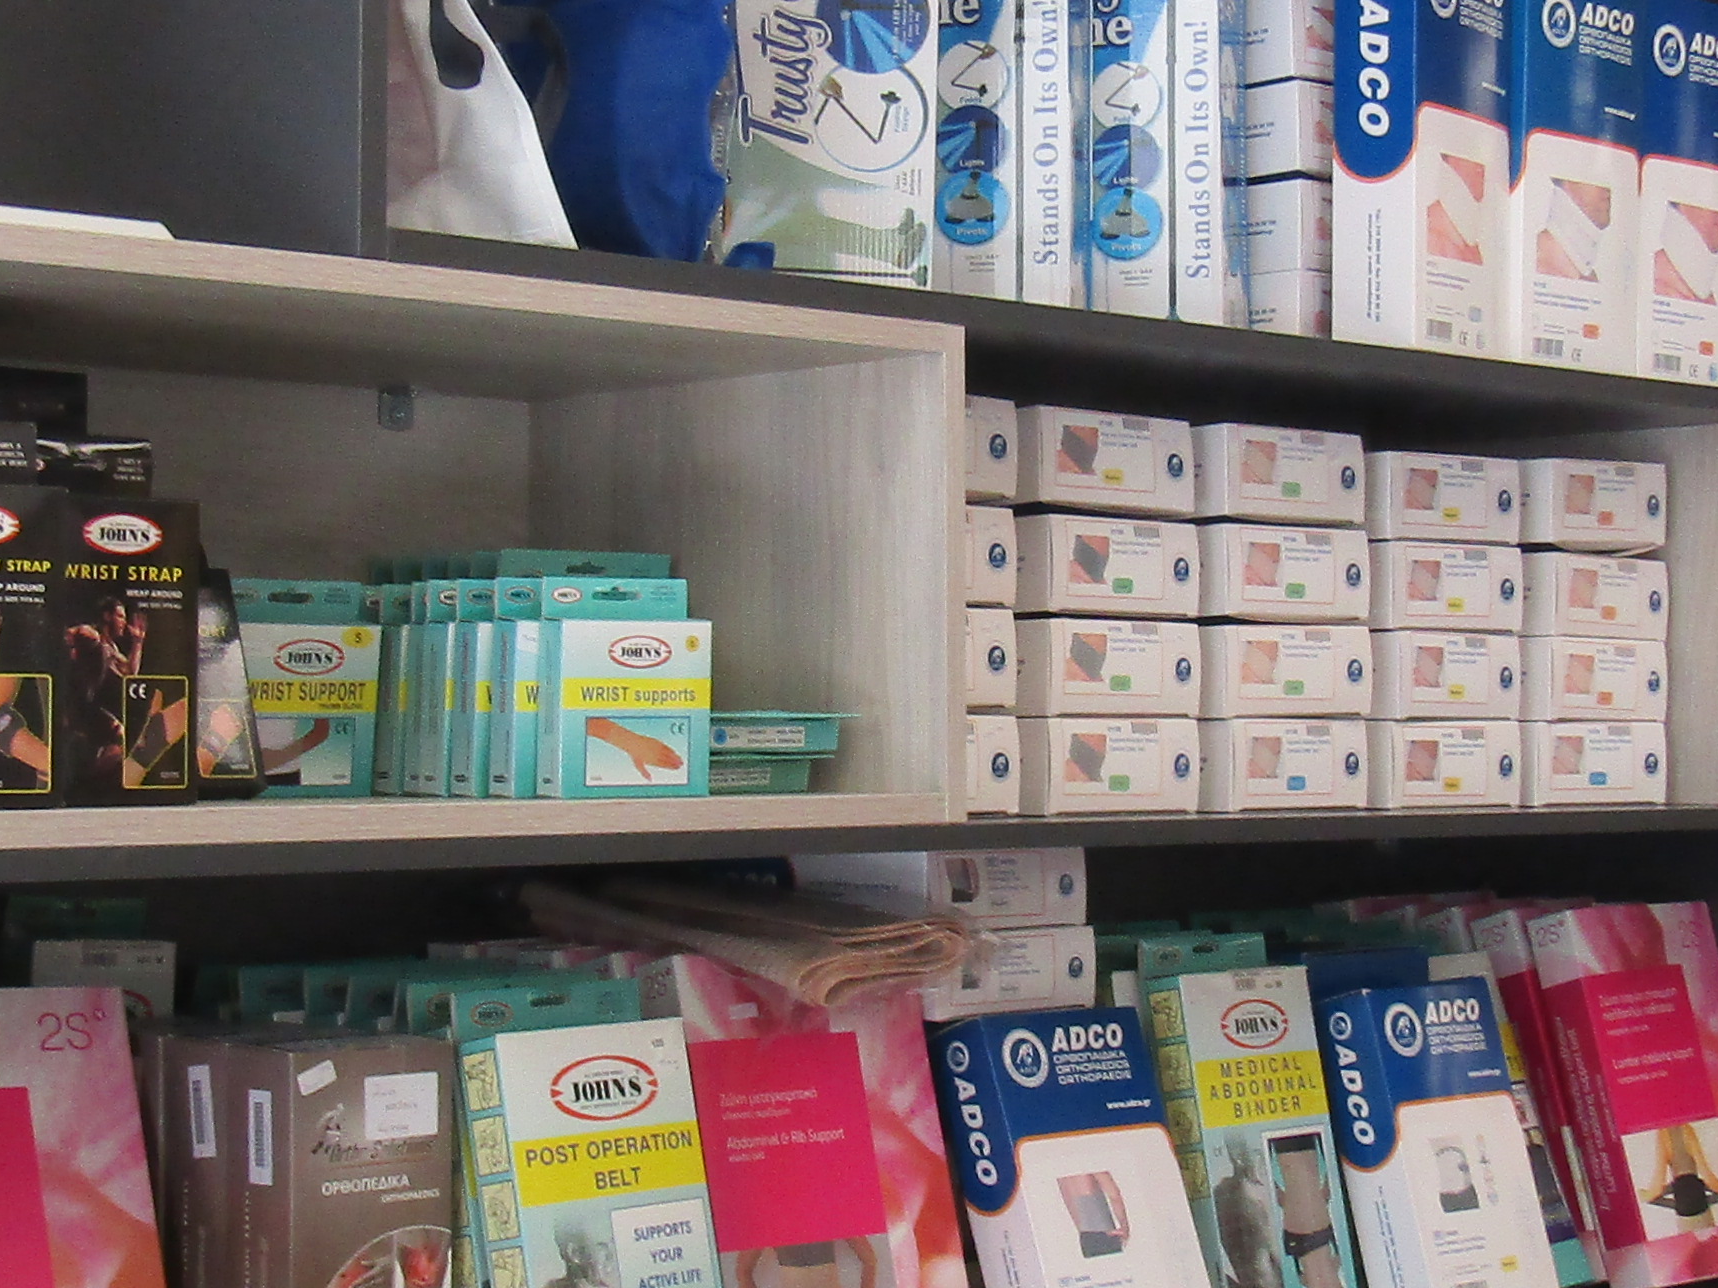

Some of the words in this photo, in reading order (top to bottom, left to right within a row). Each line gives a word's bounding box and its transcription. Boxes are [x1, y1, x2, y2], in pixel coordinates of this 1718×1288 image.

[1579, 1, 1635, 36] ADCO
[1033, 0, 1060, 74] Own!
[1184, 21, 1210, 91] Own!
[738, 9, 833, 146] Trusty
[1045, 78, 1060, 123] Its
[1196, 97, 1211, 143] Its
[1034, 129, 1060, 179] On
[1186, 148, 1211, 196] On
[1034, 182, 1060, 265] Stands
[1185, 201, 1211, 279] Stands
[98, 525, 151, 545] JOHN'S
[5, 559, 52, 574] STRAP
[128, 565, 183, 584] STRAP
[6, 581, 46, 594] AROUND
[620, 643, 662, 660] JOHN'S
[249, 682, 294, 702] WRIST
[297, 680, 366, 702] SUPPORT
[580, 686, 628, 703] WRIST
[632, 686, 697, 705] supports
[1424, 997, 1481, 1025] ADCO
[1051, 1022, 1124, 1053] ADCO
[1234, 1015, 1279, 1036] JOHN'S
[1220, 1059, 1302, 1078] MEDICAL
[571, 1076, 643, 1103] JOHN'S
[1209, 1075, 1317, 1101] ABDOMINAL
[1334, 1044, 1376, 1146] ADCO
[1234, 1095, 1302, 1119] BINDER
[808, 1127, 846, 1144] Support
[953, 1076, 999, 1188] ADCO
[525, 1143, 580, 1168] POST
[586, 1130, 693, 1160] OPERATION
[321, 1173, 412, 1198] ΟΡΘΟΠΕΔΙΚΑ
[594, 1167, 642, 1191] BELT
[633, 1220, 693, 1242] SUPPORTS
[650, 1248, 684, 1264] YOUR
[682, 1268, 702, 1285] LIFE
